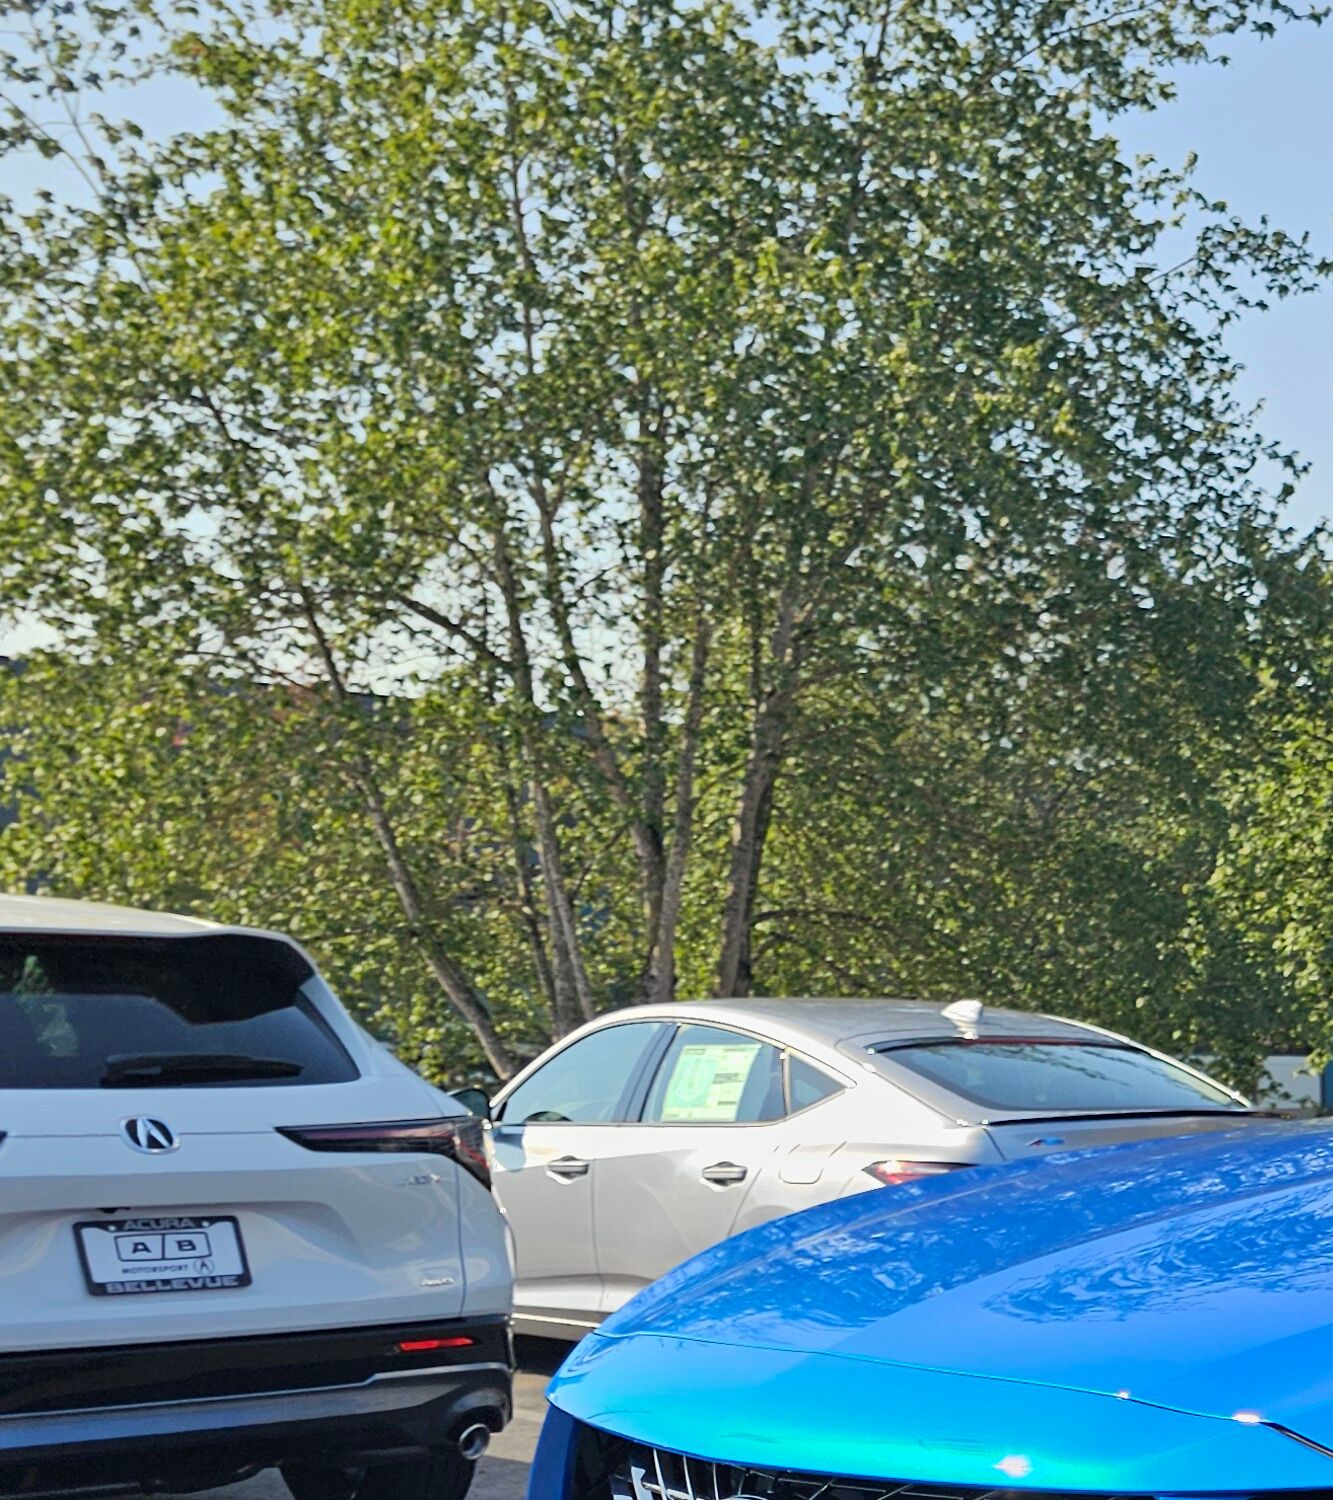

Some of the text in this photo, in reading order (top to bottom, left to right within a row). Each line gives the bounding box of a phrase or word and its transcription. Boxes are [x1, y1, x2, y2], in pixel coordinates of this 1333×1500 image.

[123, 1217, 196, 1231] ACURA
[121, 1264, 188, 1275] MOTORSPORT
[106, 1275, 239, 1293] BELLEVUE
